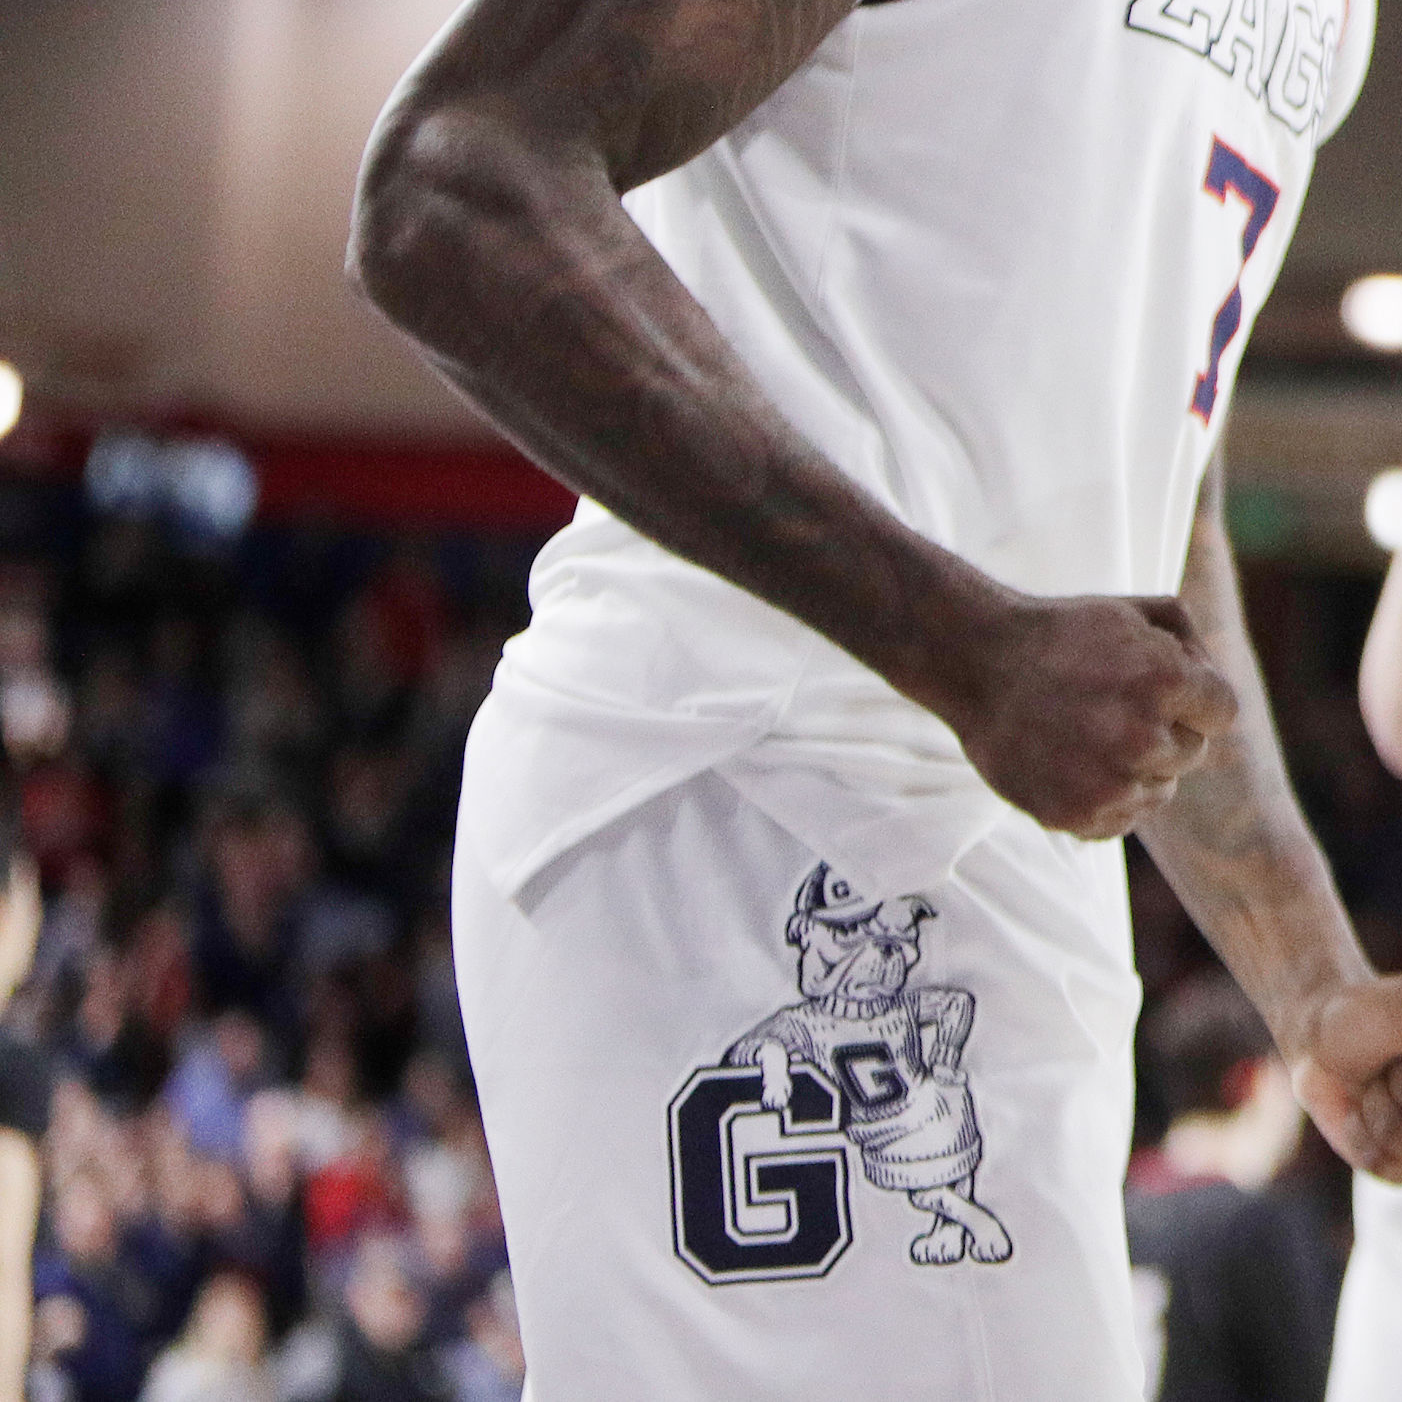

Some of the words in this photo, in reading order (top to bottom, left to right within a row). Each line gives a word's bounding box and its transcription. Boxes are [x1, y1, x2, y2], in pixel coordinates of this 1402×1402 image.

[1189, 133, 1281, 429] 7
[668, 1064, 854, 1286] G
[831, 1041, 909, 1107] G
